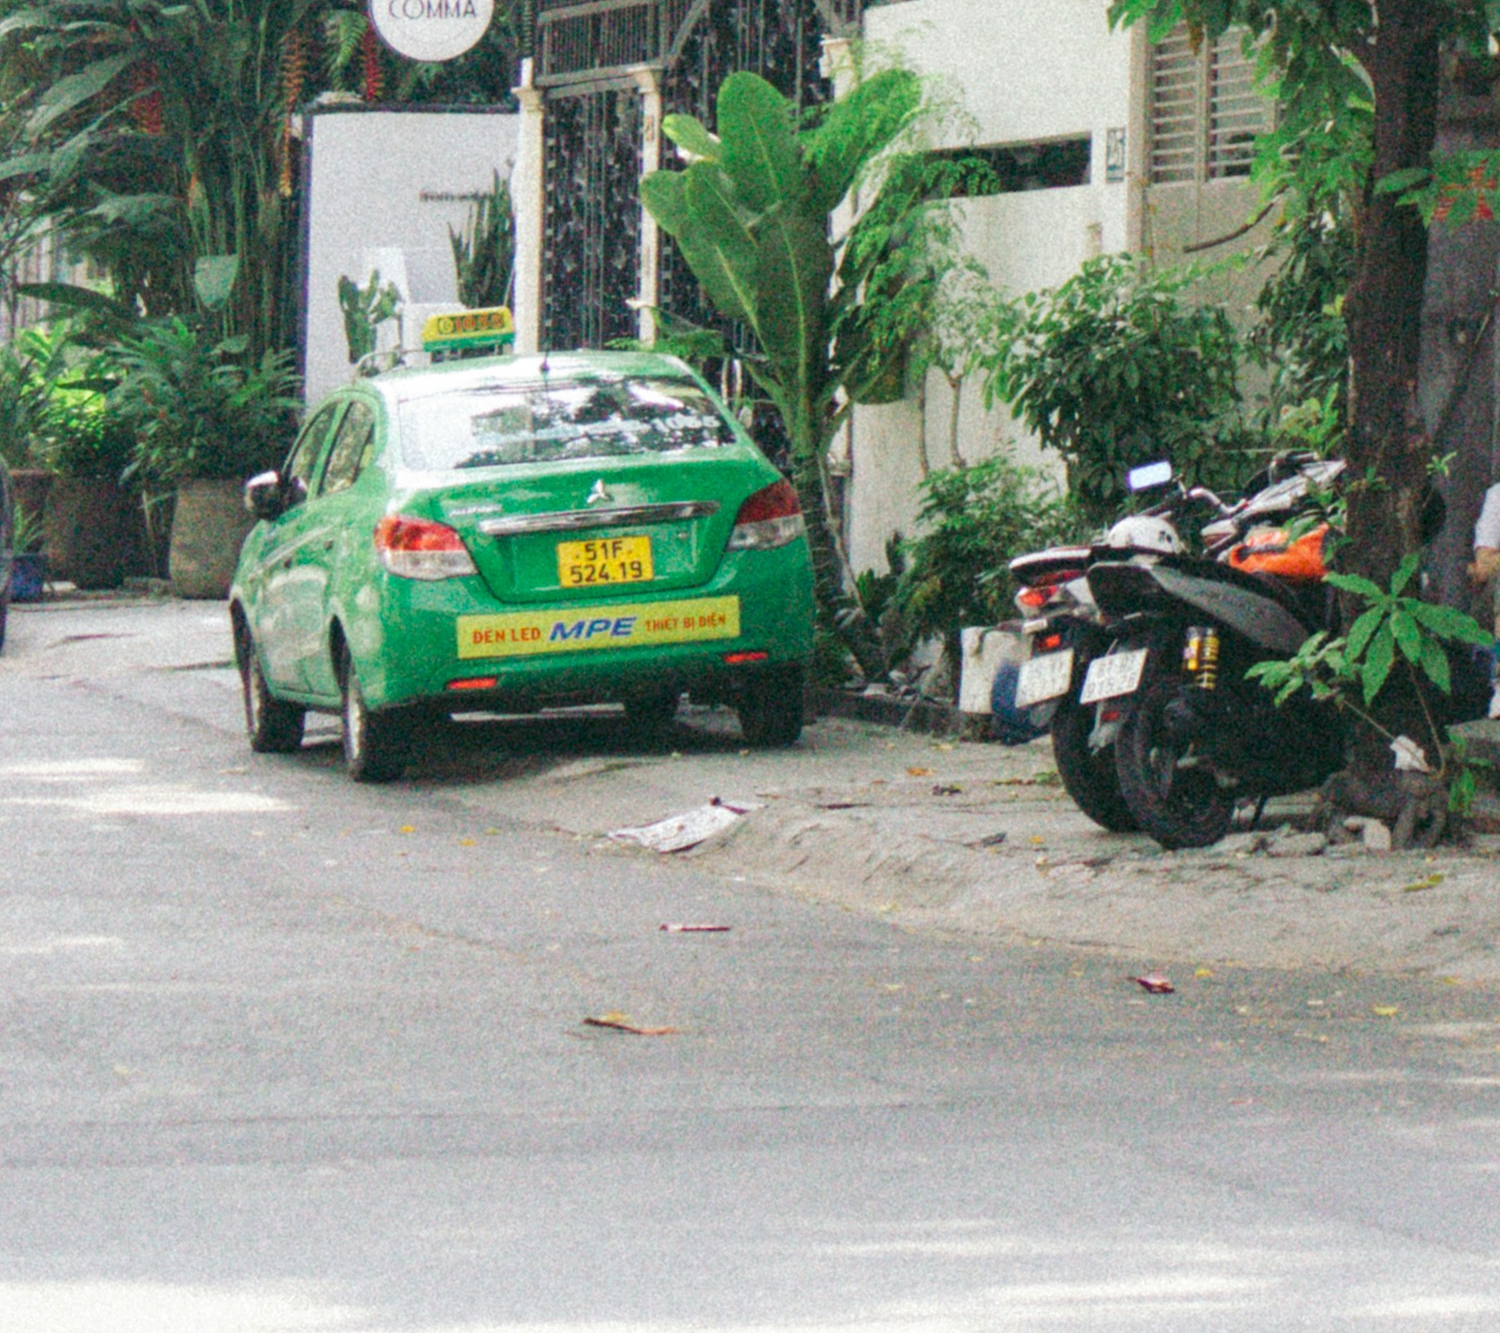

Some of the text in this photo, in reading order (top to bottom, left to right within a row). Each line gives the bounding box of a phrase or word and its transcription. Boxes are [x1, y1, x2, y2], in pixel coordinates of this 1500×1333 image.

[584, 539, 623, 561] 51F
[568, 560, 643, 584] 524.19
[511, 626, 541, 643] LED
[549, 616, 638, 641] MPE
